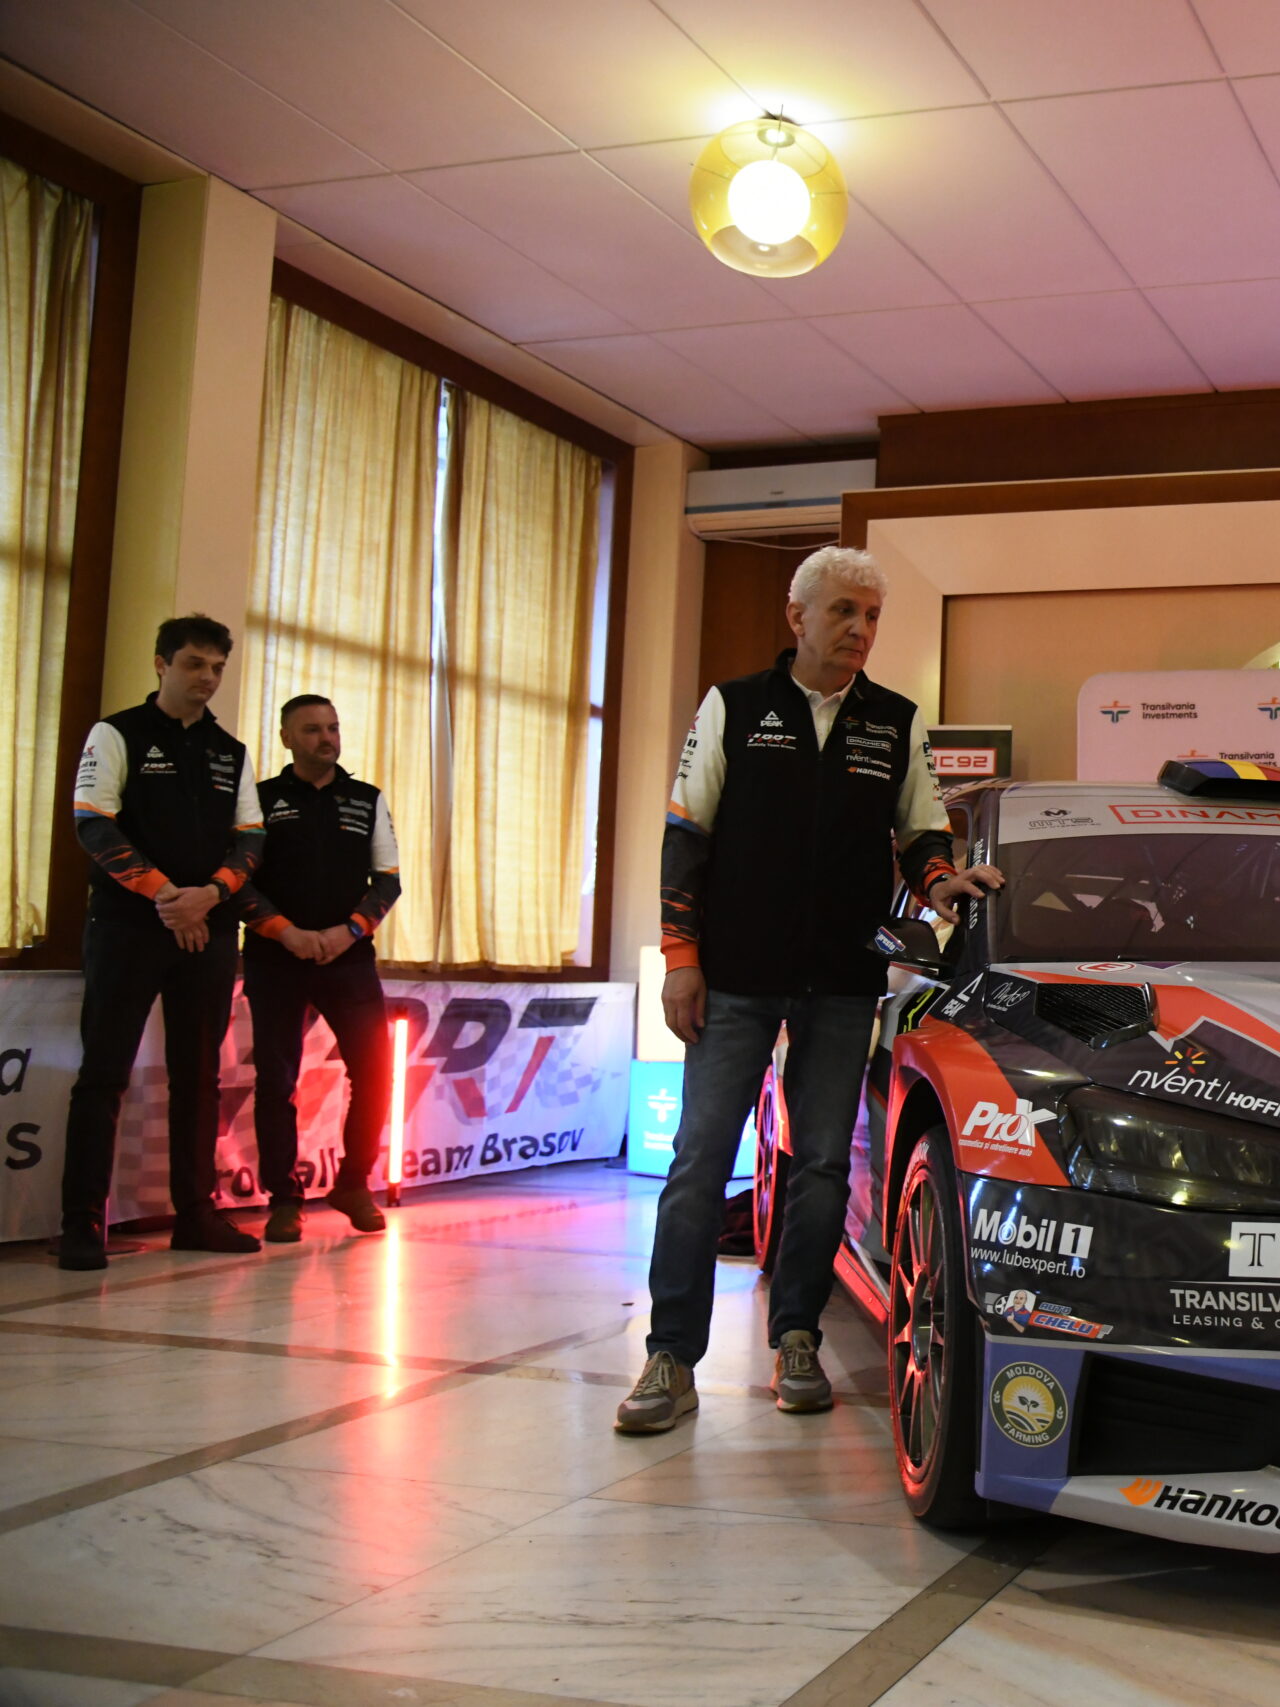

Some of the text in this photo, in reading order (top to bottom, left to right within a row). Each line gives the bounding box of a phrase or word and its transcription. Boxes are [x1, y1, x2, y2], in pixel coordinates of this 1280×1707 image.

[1141, 703, 1196, 711] Transilvania
[1142, 711, 1198, 720] Investments
[1219, 752, 1275, 760] Transilvania
[1128, 1067, 1222, 1100] nvent
[973, 1208, 1058, 1252] Mobil
[1239, 1232, 1276, 1267] T
[970, 1247, 1086, 1279] www.lubexpert.ro
[1038, 1302, 1072, 1315] AUTO
[1034, 1314, 1094, 1334] CHELU
[1173, 1314, 1243, 1328] LEASING
[1250, 1316, 1265, 1330] &
[1006, 1365, 1056, 1390] MOLDOVA
[1003, 1423, 1050, 1443] FARMING
